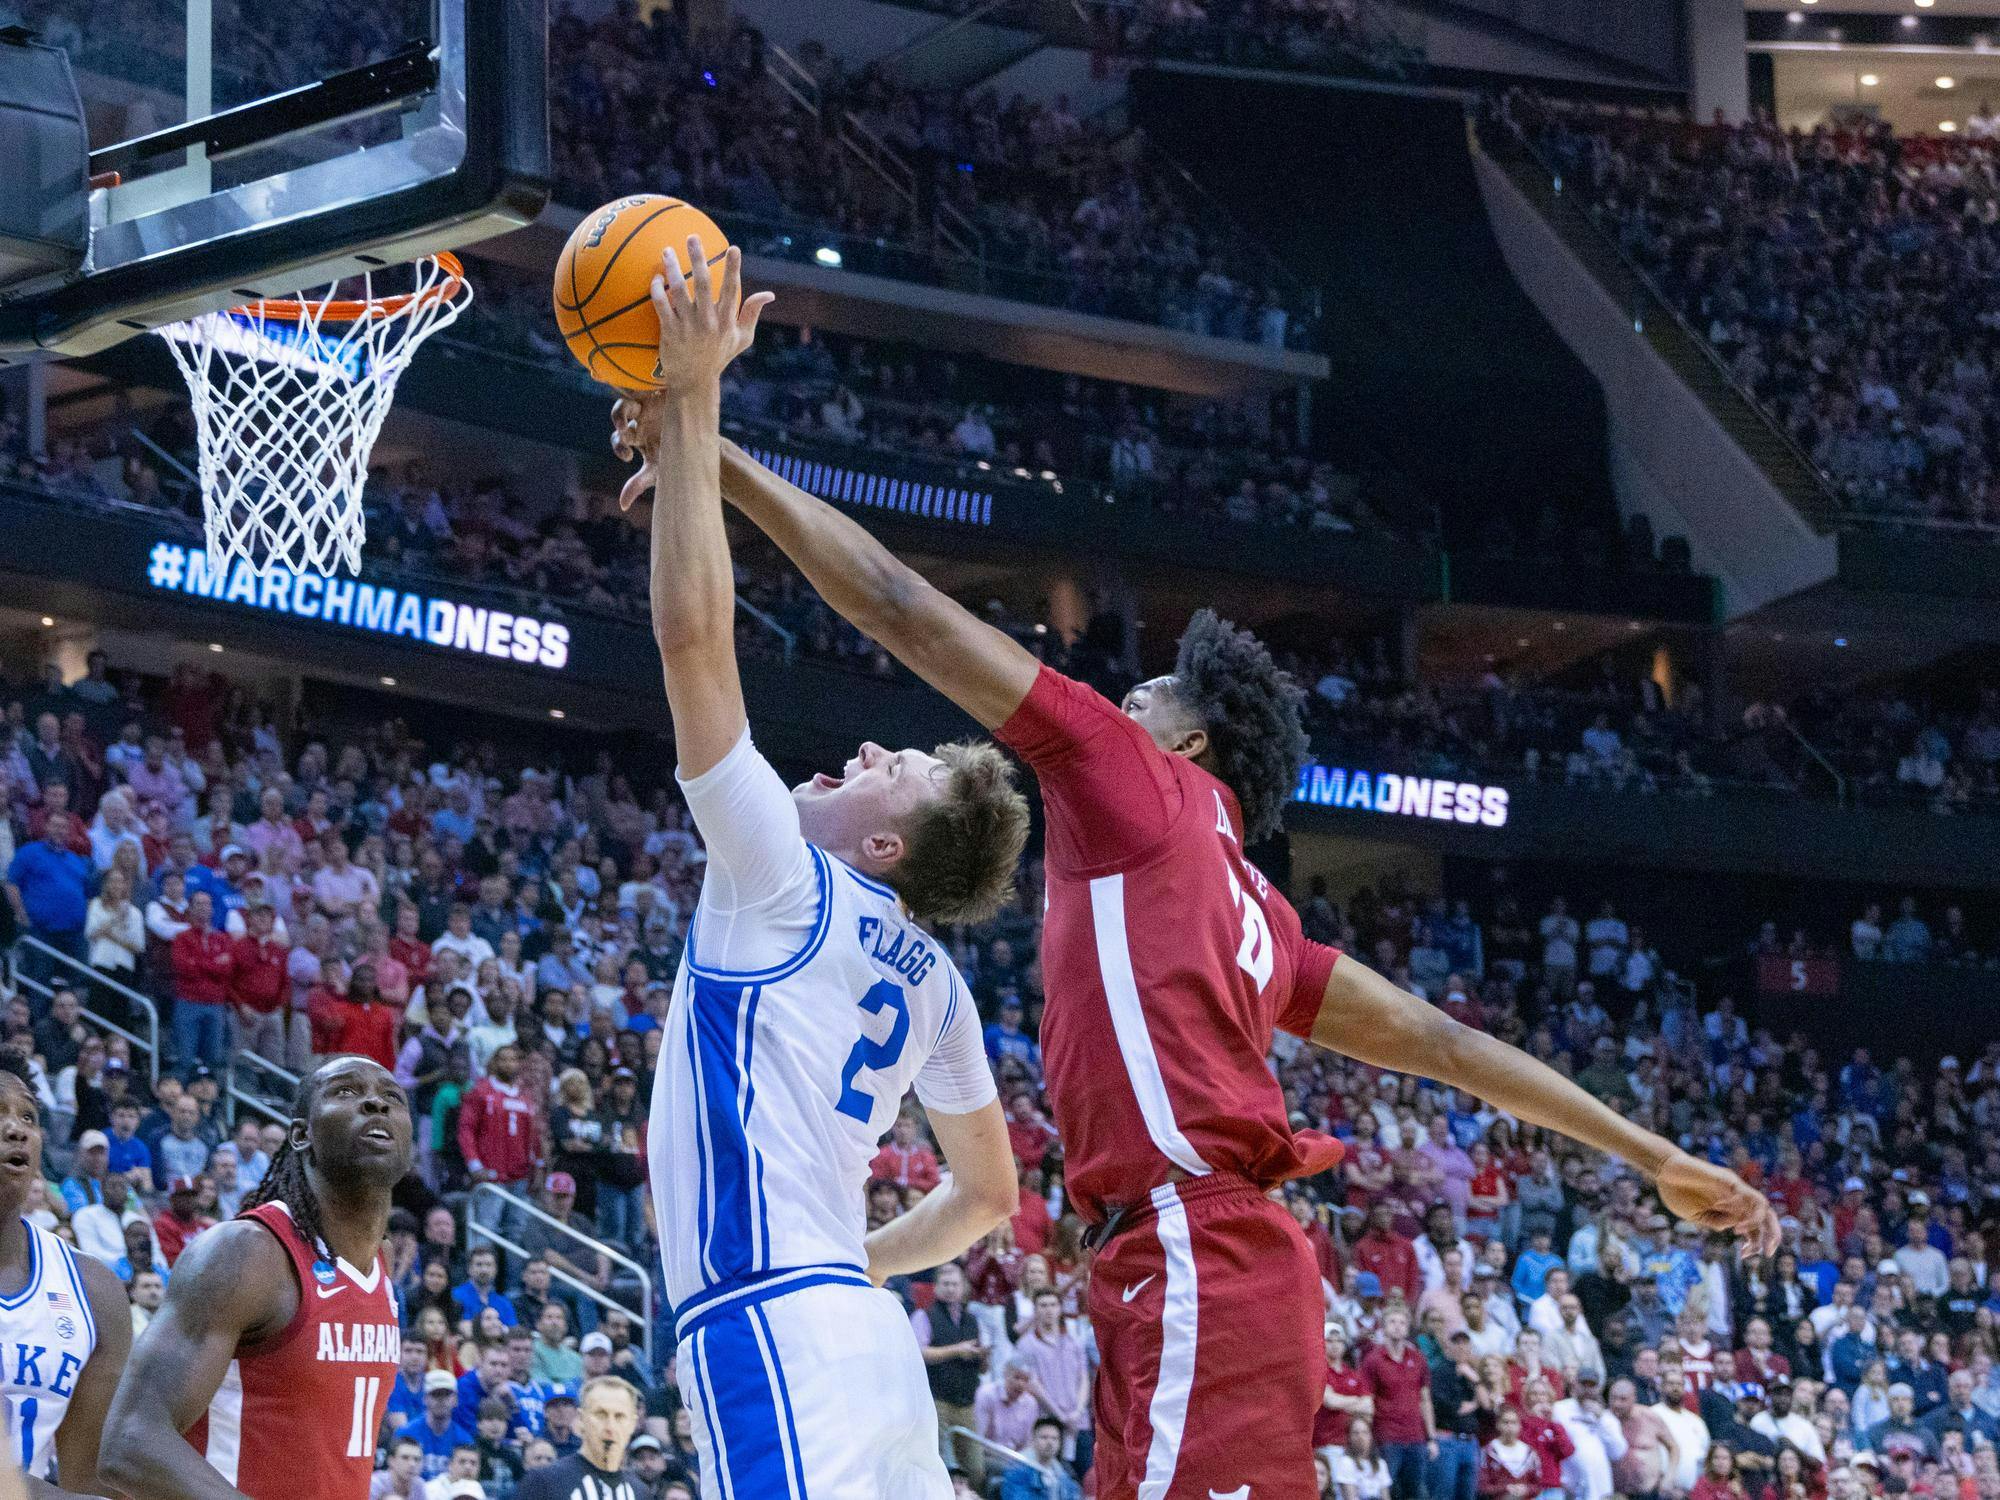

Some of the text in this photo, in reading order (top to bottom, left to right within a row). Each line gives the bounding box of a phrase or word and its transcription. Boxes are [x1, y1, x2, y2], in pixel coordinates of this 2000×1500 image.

[148, 542, 571, 668] #MARCHMADNESS
[858, 915, 937, 988] FLAGG
[1790, 960, 1808, 991] 5
[835, 977, 910, 1125] 2
[0, 1342, 83, 1399] KE
[346, 1376, 380, 1457] 11
